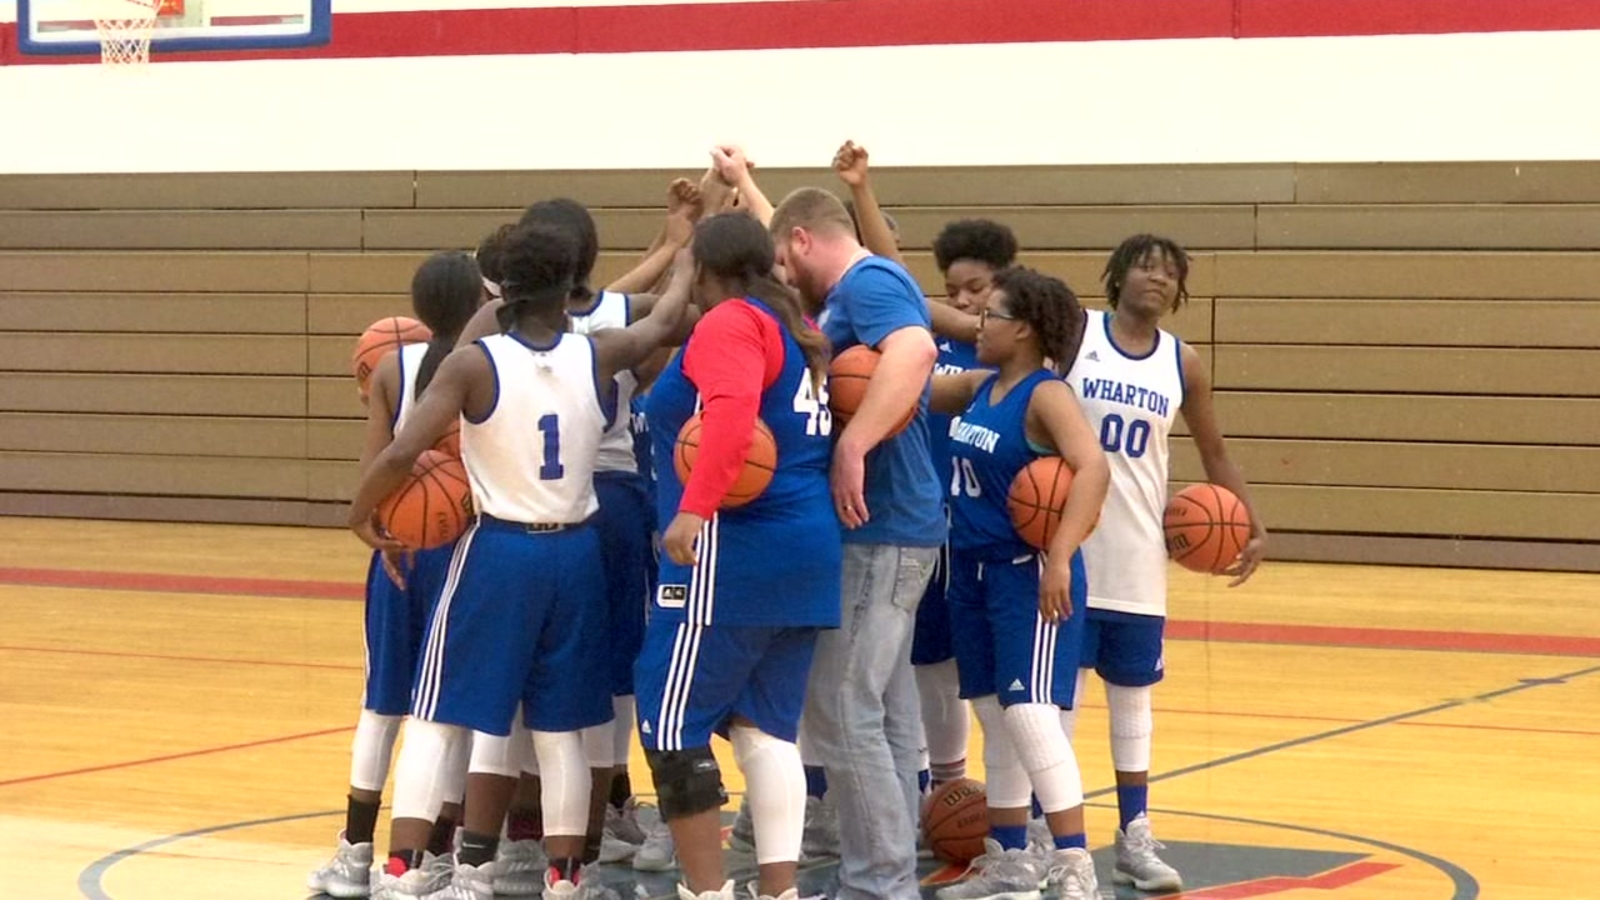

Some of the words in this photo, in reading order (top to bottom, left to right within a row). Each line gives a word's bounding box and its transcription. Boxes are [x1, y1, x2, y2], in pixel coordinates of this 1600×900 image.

[1083, 377, 1169, 418] WHARTON
[537, 414, 564, 480] 1
[1100, 413, 1151, 459] 00
[950, 456, 981, 498] 10
